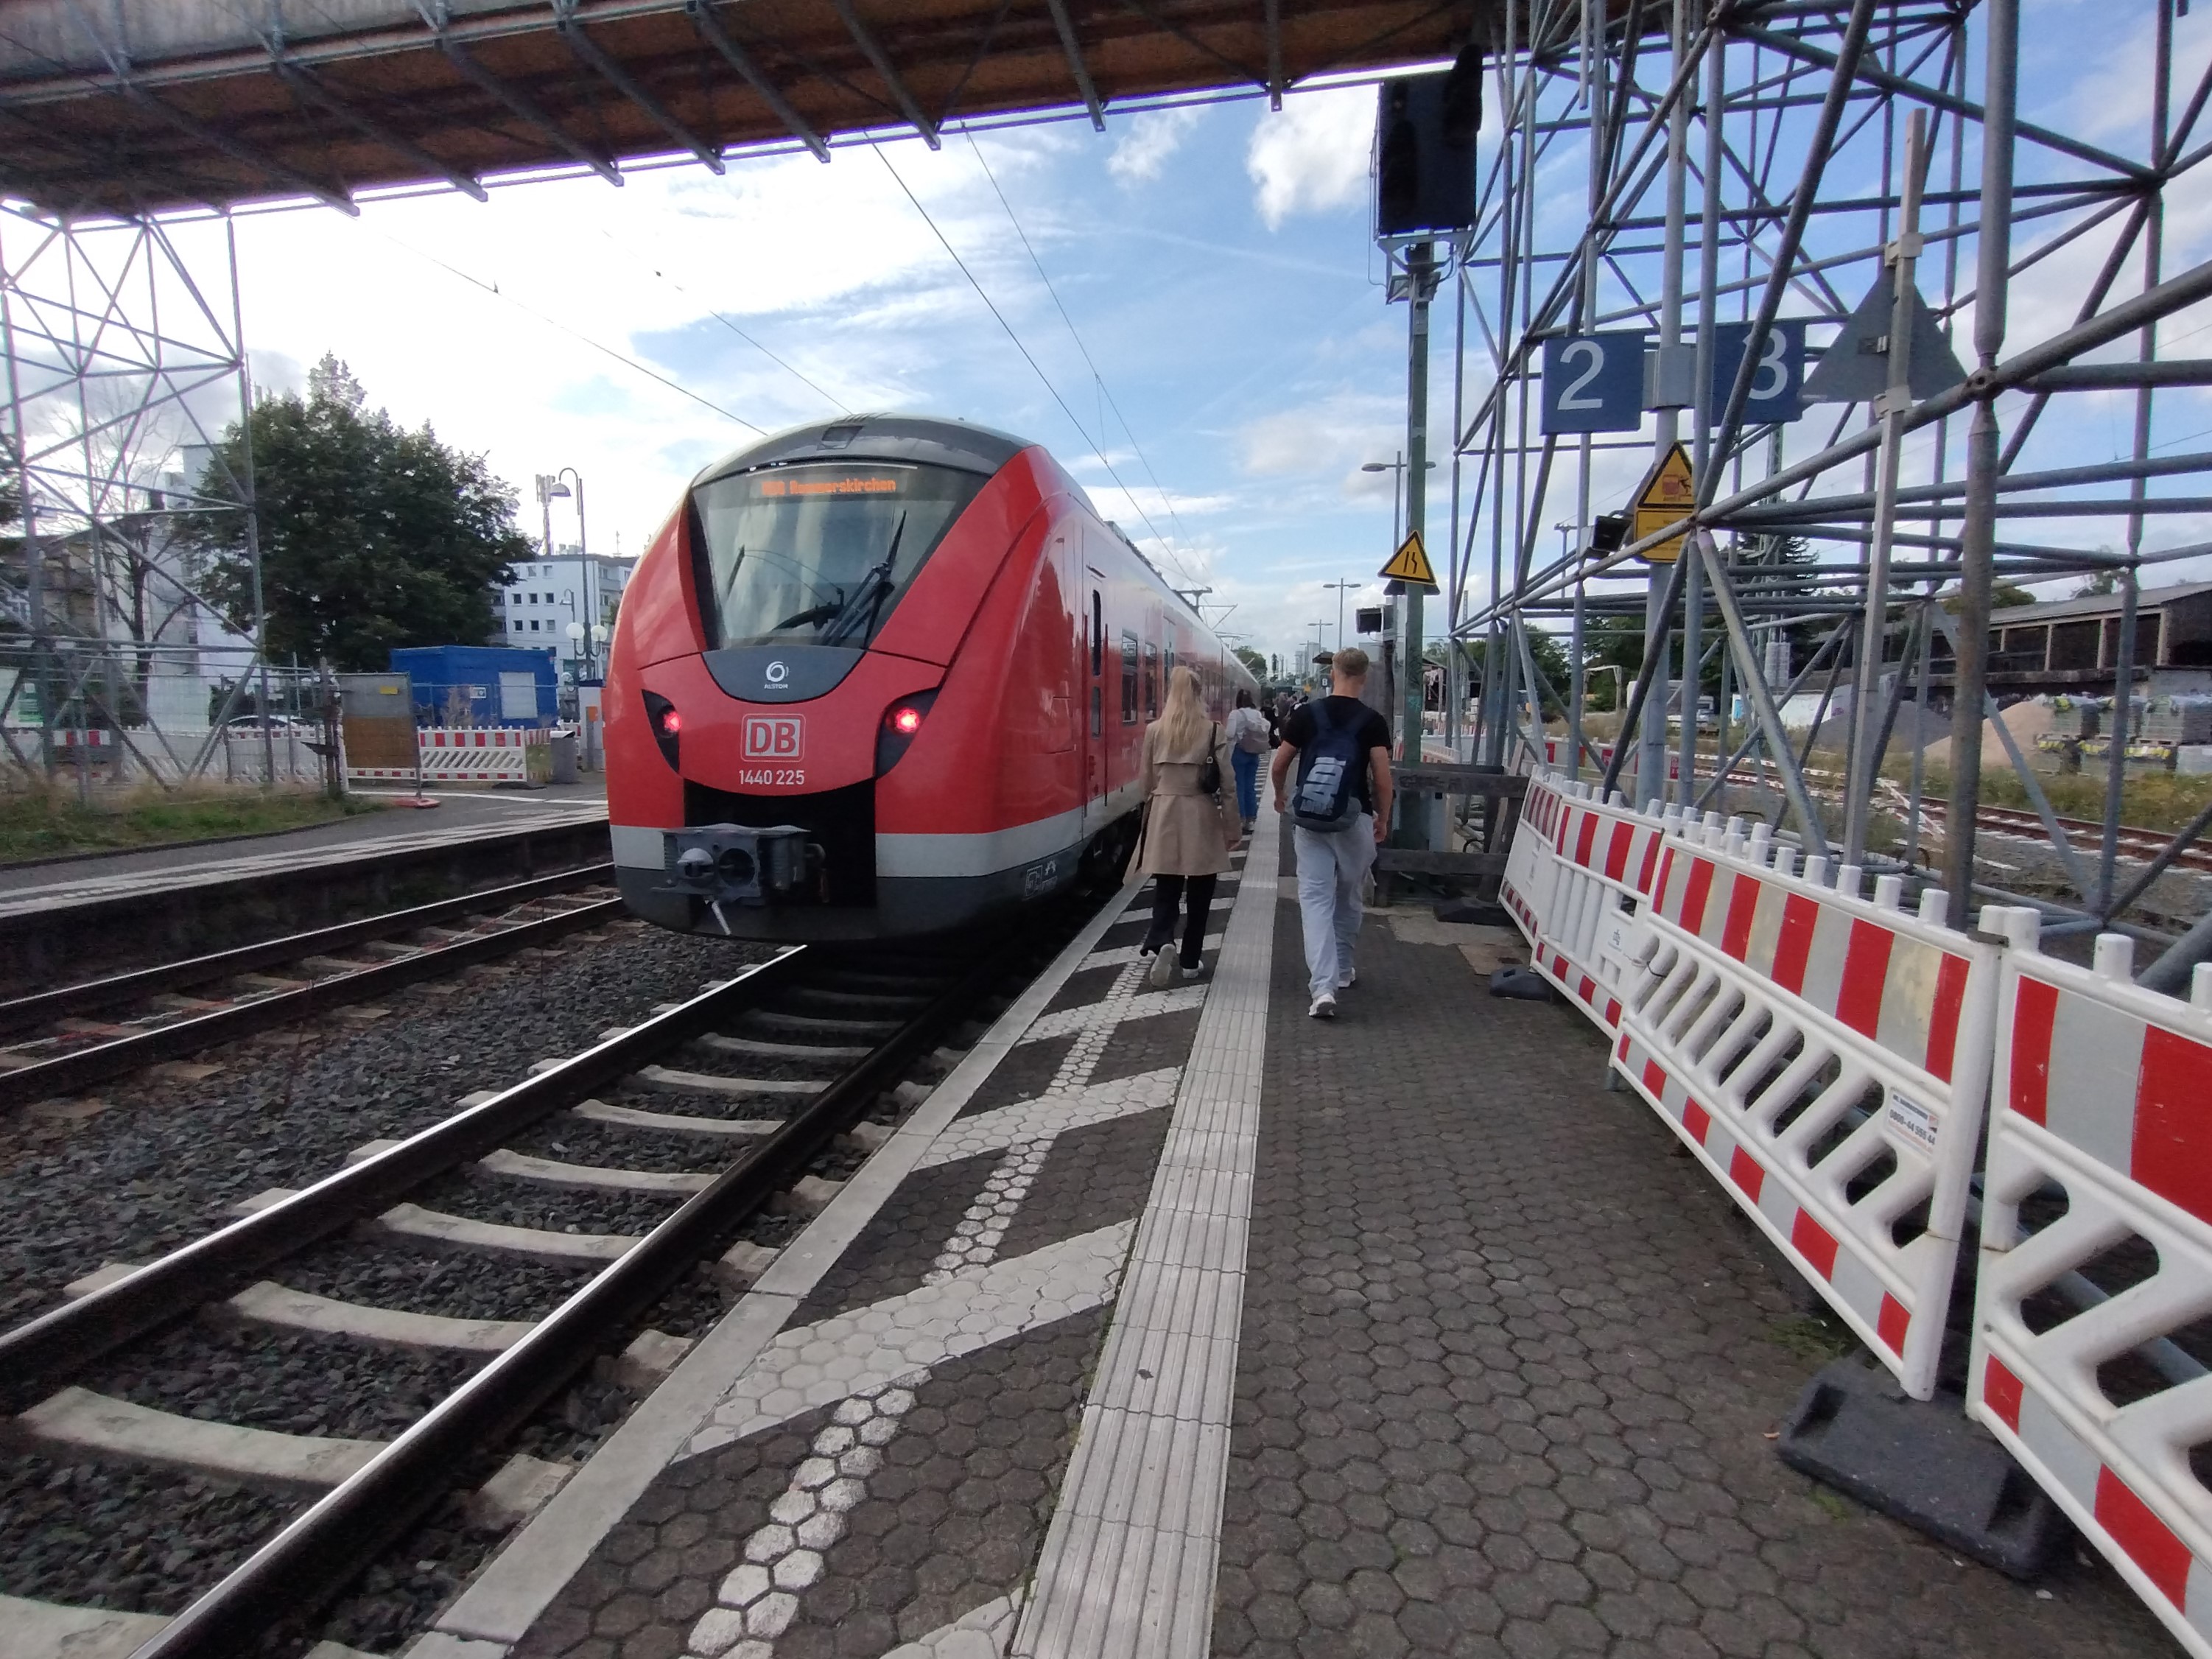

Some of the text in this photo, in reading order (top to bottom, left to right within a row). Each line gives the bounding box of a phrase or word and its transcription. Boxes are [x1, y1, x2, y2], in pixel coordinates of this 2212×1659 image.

[1557, 340, 1604, 410] 2
[1742, 328, 1788, 400] 3
[749, 722, 796, 754] DB
[739, 769, 805, 785] 1440 225
